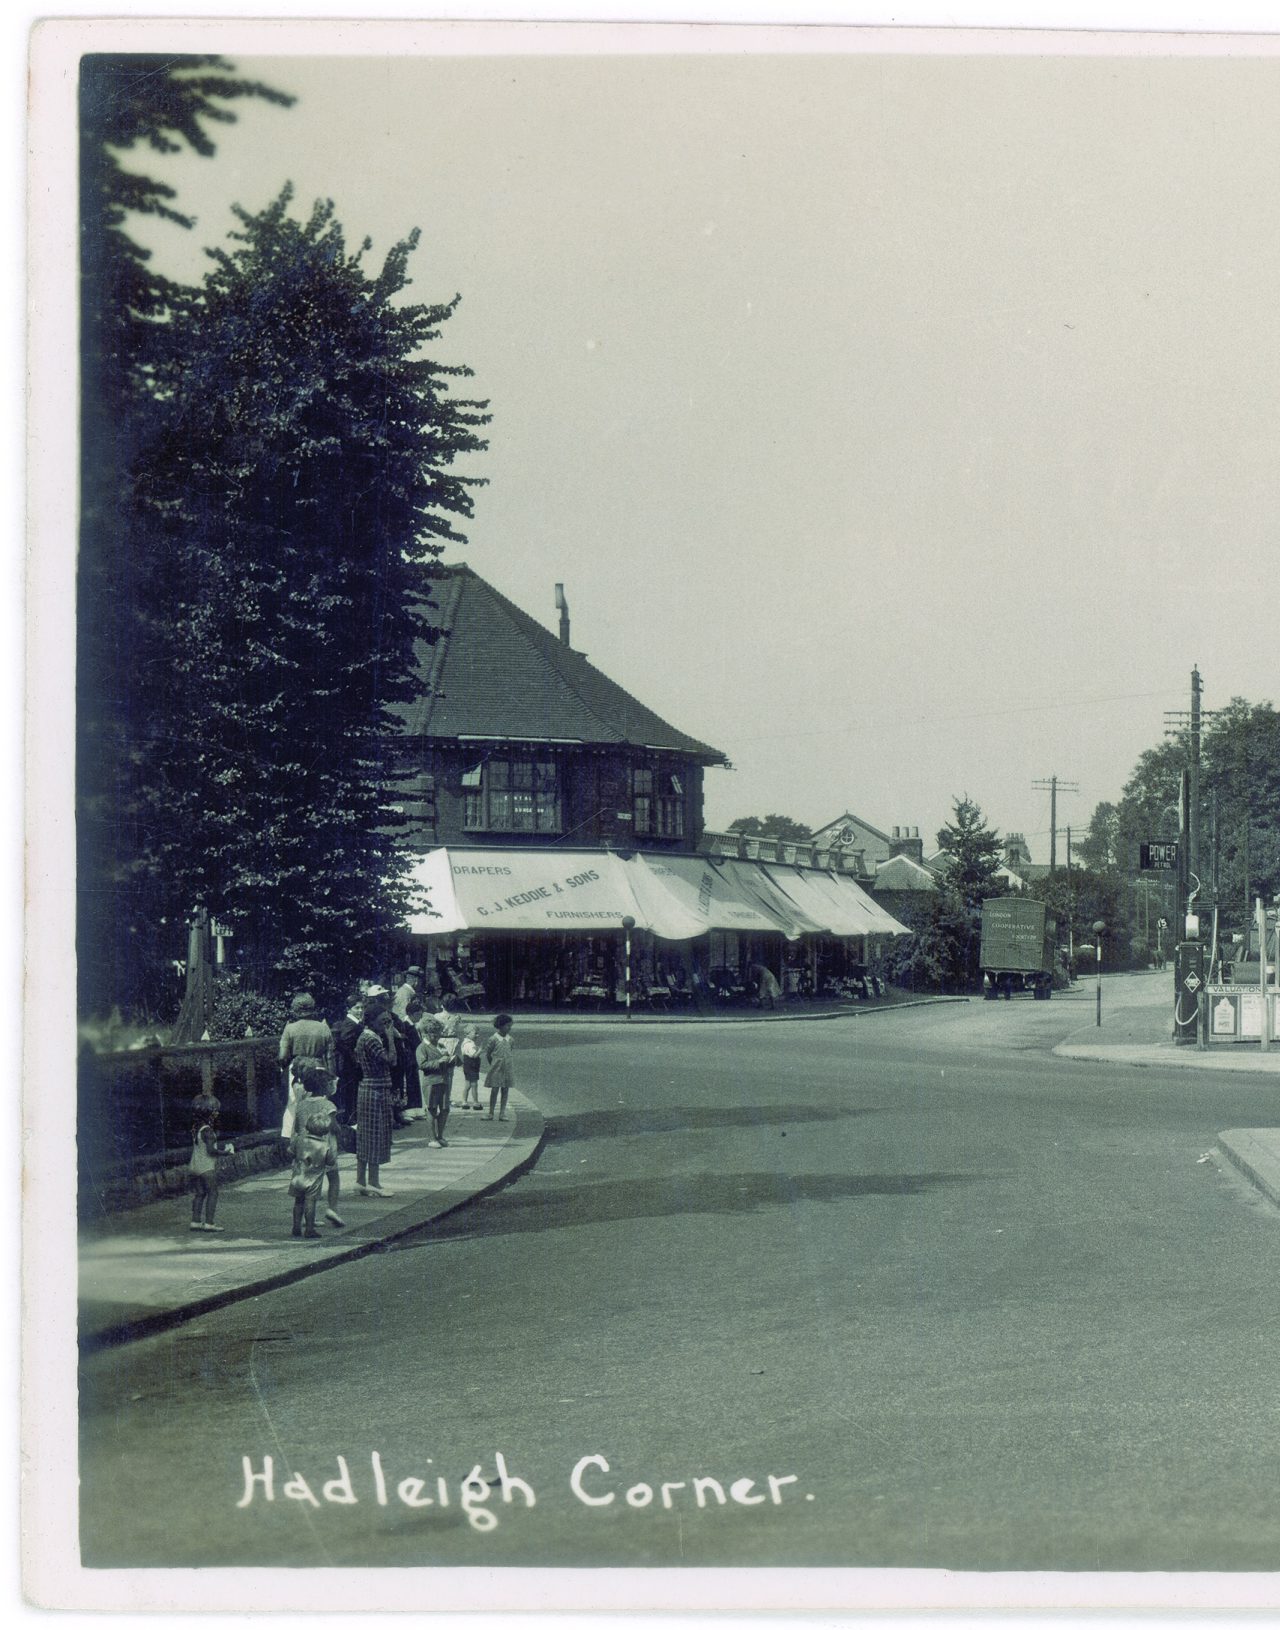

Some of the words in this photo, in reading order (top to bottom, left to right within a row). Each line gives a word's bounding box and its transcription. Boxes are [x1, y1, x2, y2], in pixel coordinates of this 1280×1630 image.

[1149, 844, 1176, 861] POWER
[452, 865, 513, 876] DRAPERS
[504, 886, 552, 909] KEDDIE
[552, 882, 565, 894] &
[565, 869, 601, 889] SONS
[545, 910, 624, 919] FURNISHERS
